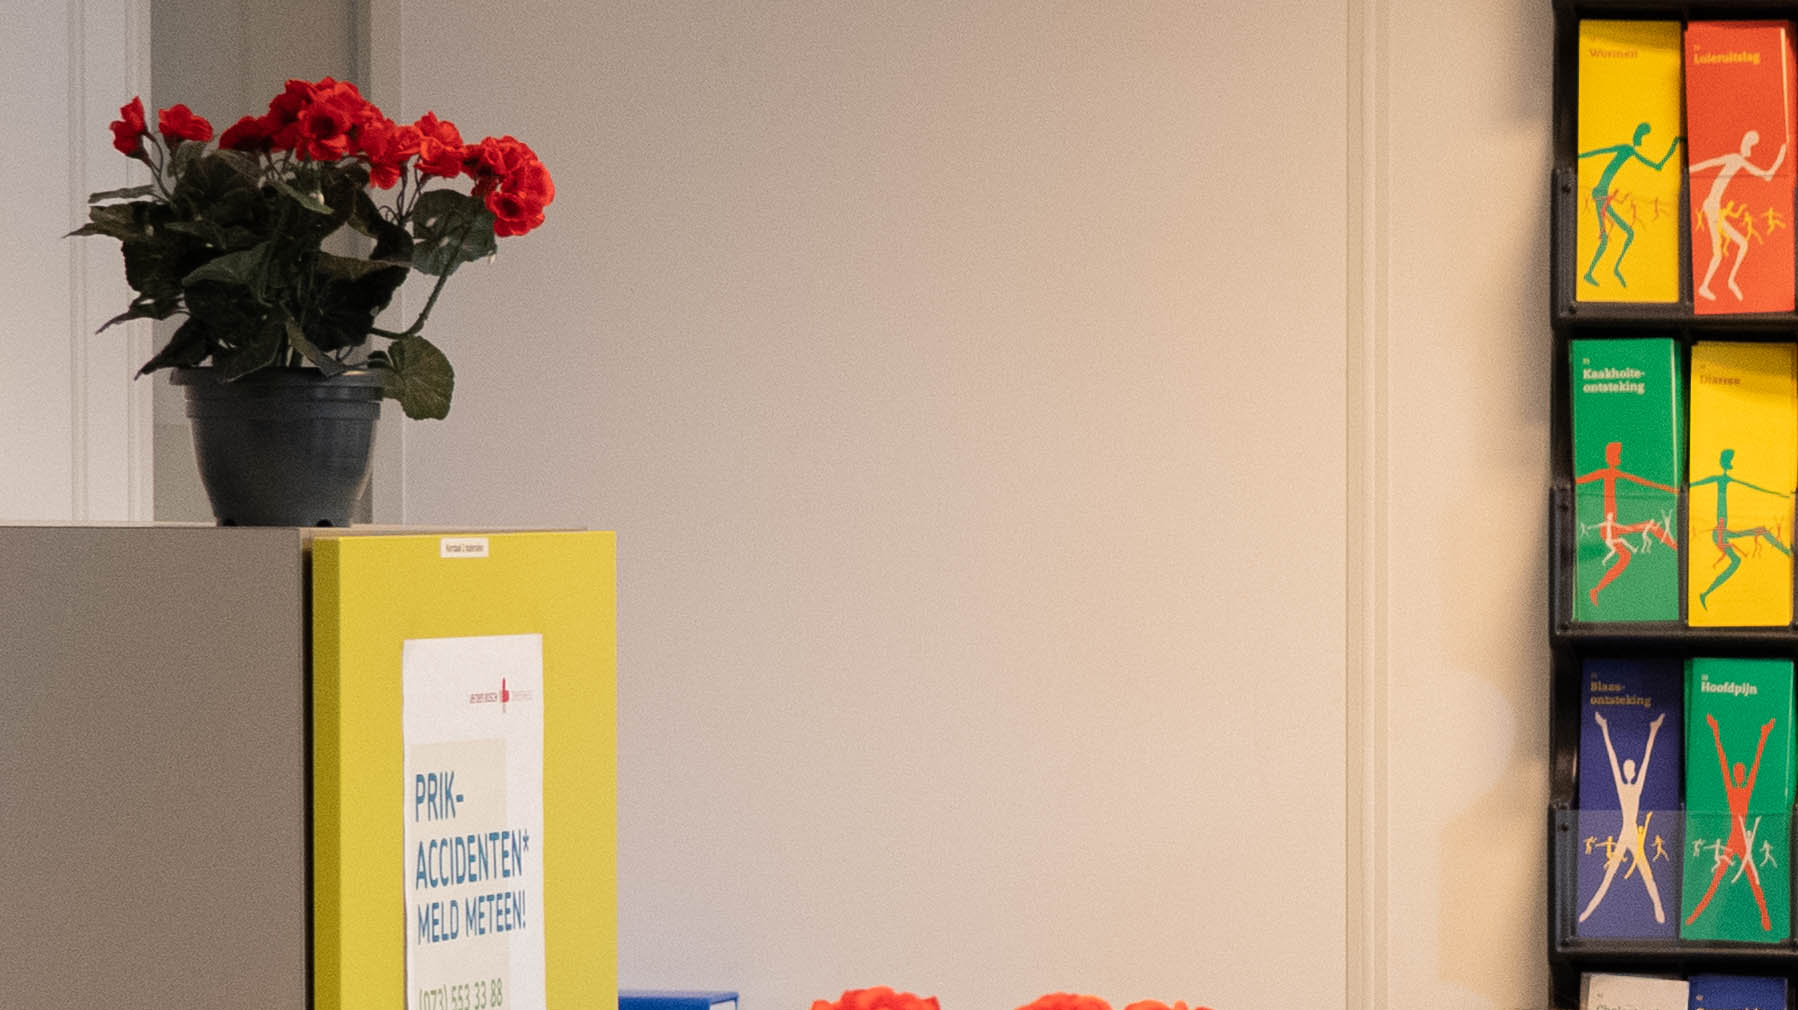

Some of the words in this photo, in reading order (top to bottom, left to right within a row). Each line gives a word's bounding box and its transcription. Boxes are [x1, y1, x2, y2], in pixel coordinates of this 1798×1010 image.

[1582, 367, 1646, 380] Kaakholte-
[1582, 381, 1646, 395] ontsteking
[1701, 681, 1757, 696] Hoofdpijn
[415, 770, 464, 822] PRIK-
[418, 899, 460, 946] MELD
[465, 889, 527, 938] METEEN!
[474, 980, 487, 1010] 33
[490, 977, 503, 1008] 88
